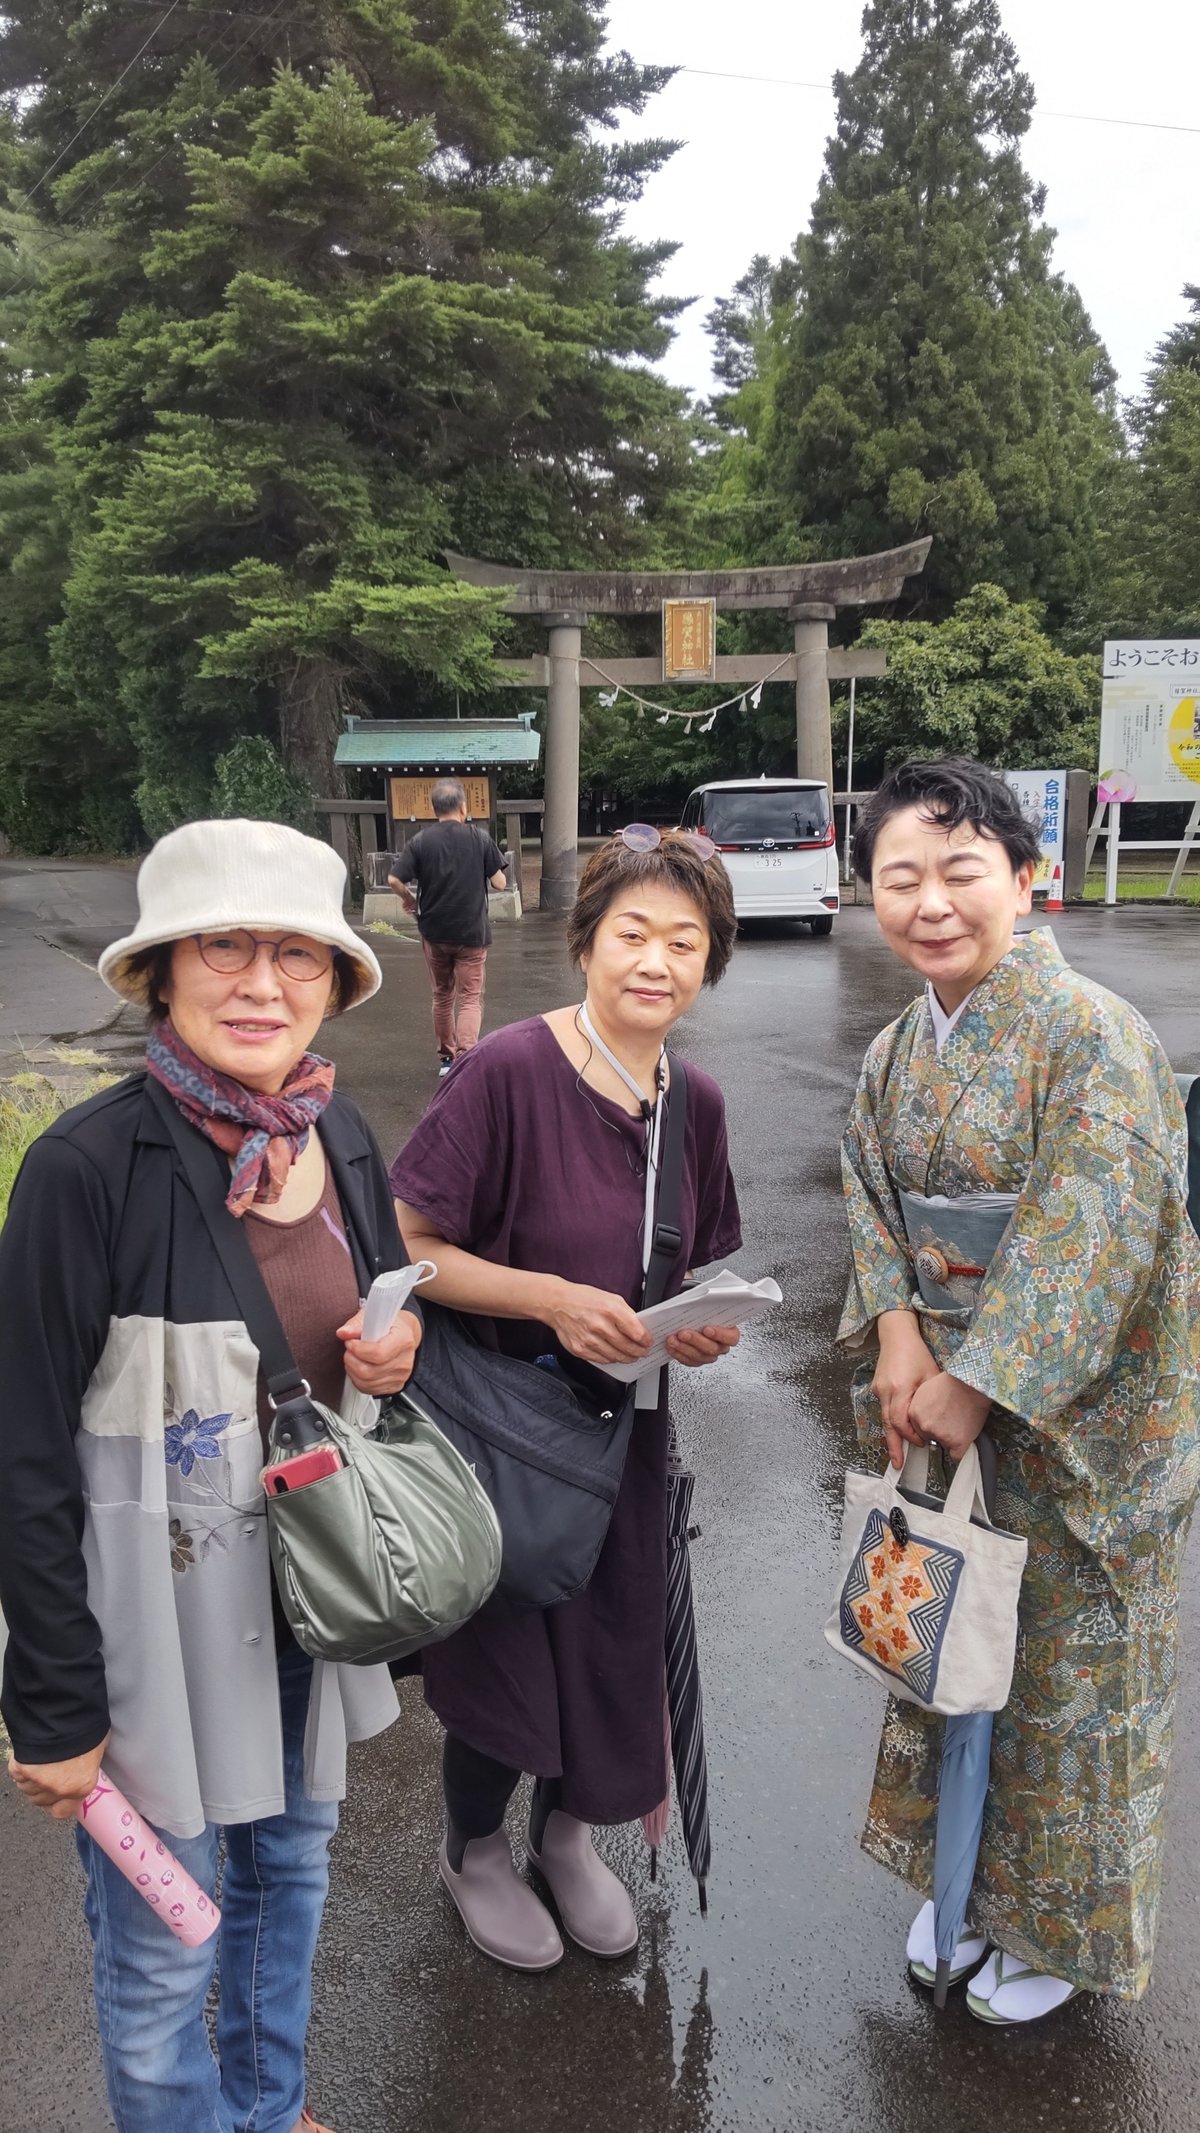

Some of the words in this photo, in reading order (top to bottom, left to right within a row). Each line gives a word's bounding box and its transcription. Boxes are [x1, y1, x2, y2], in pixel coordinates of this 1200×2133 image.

[1109, 647, 1199, 667] ようこそお
[1042, 779, 1060, 843] 合格祈願
